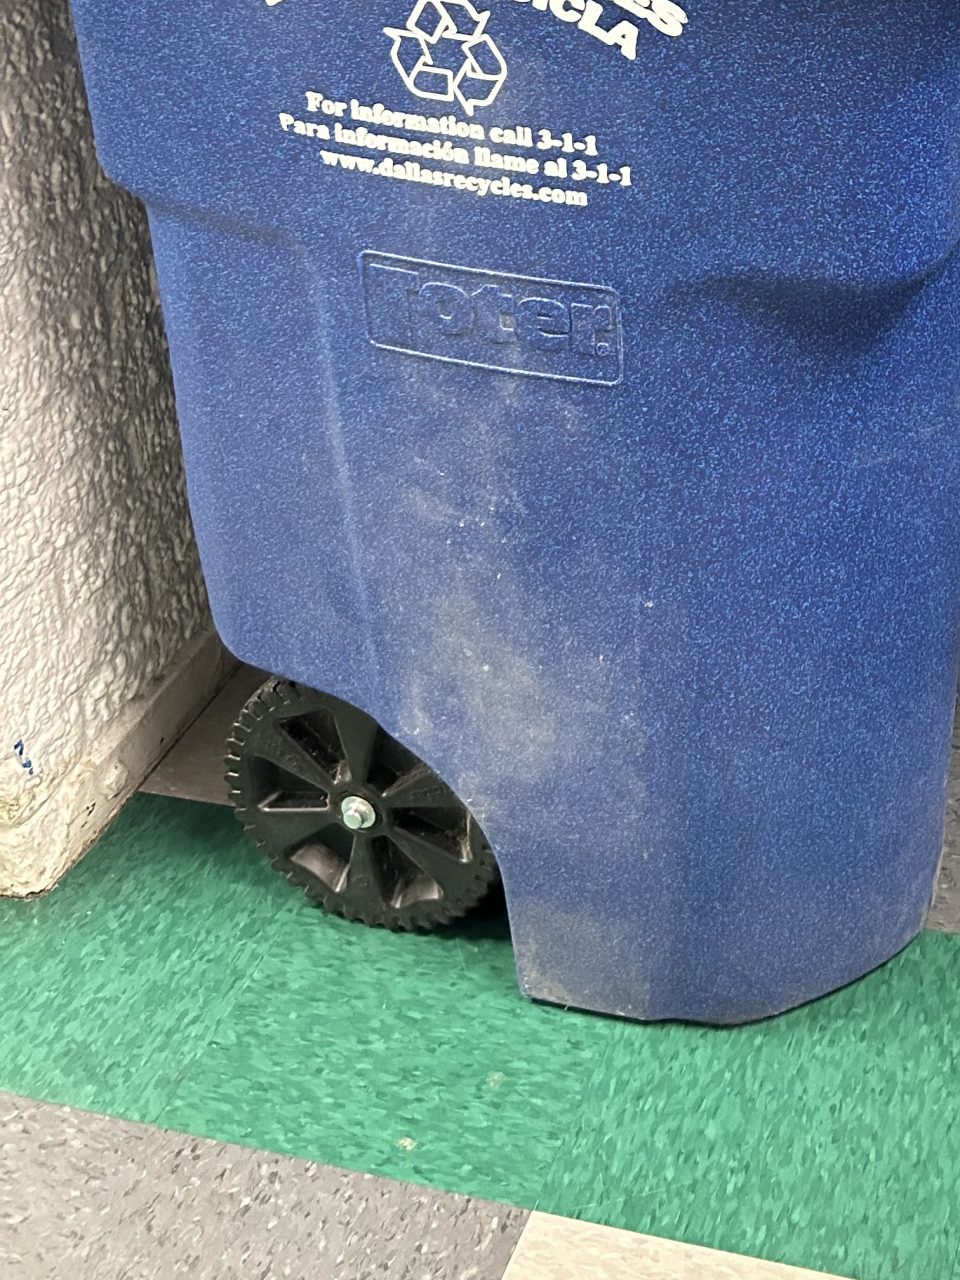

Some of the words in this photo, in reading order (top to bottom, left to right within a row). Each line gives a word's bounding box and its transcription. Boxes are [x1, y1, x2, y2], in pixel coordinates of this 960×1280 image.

[279, 113, 330, 141] Para
[335, 123, 469, 166] información
[474, 146, 539, 176] llame
[544, 160, 568, 179] al
[572, 160, 632, 187] 3-1-1
[305, 91, 347, 118] For
[351, 99, 485, 140] information
[490, 125, 532, 148] call
[538, 129, 599, 157] 3-1-1
[320, 149, 589, 207] www.dallasrecycles.com
